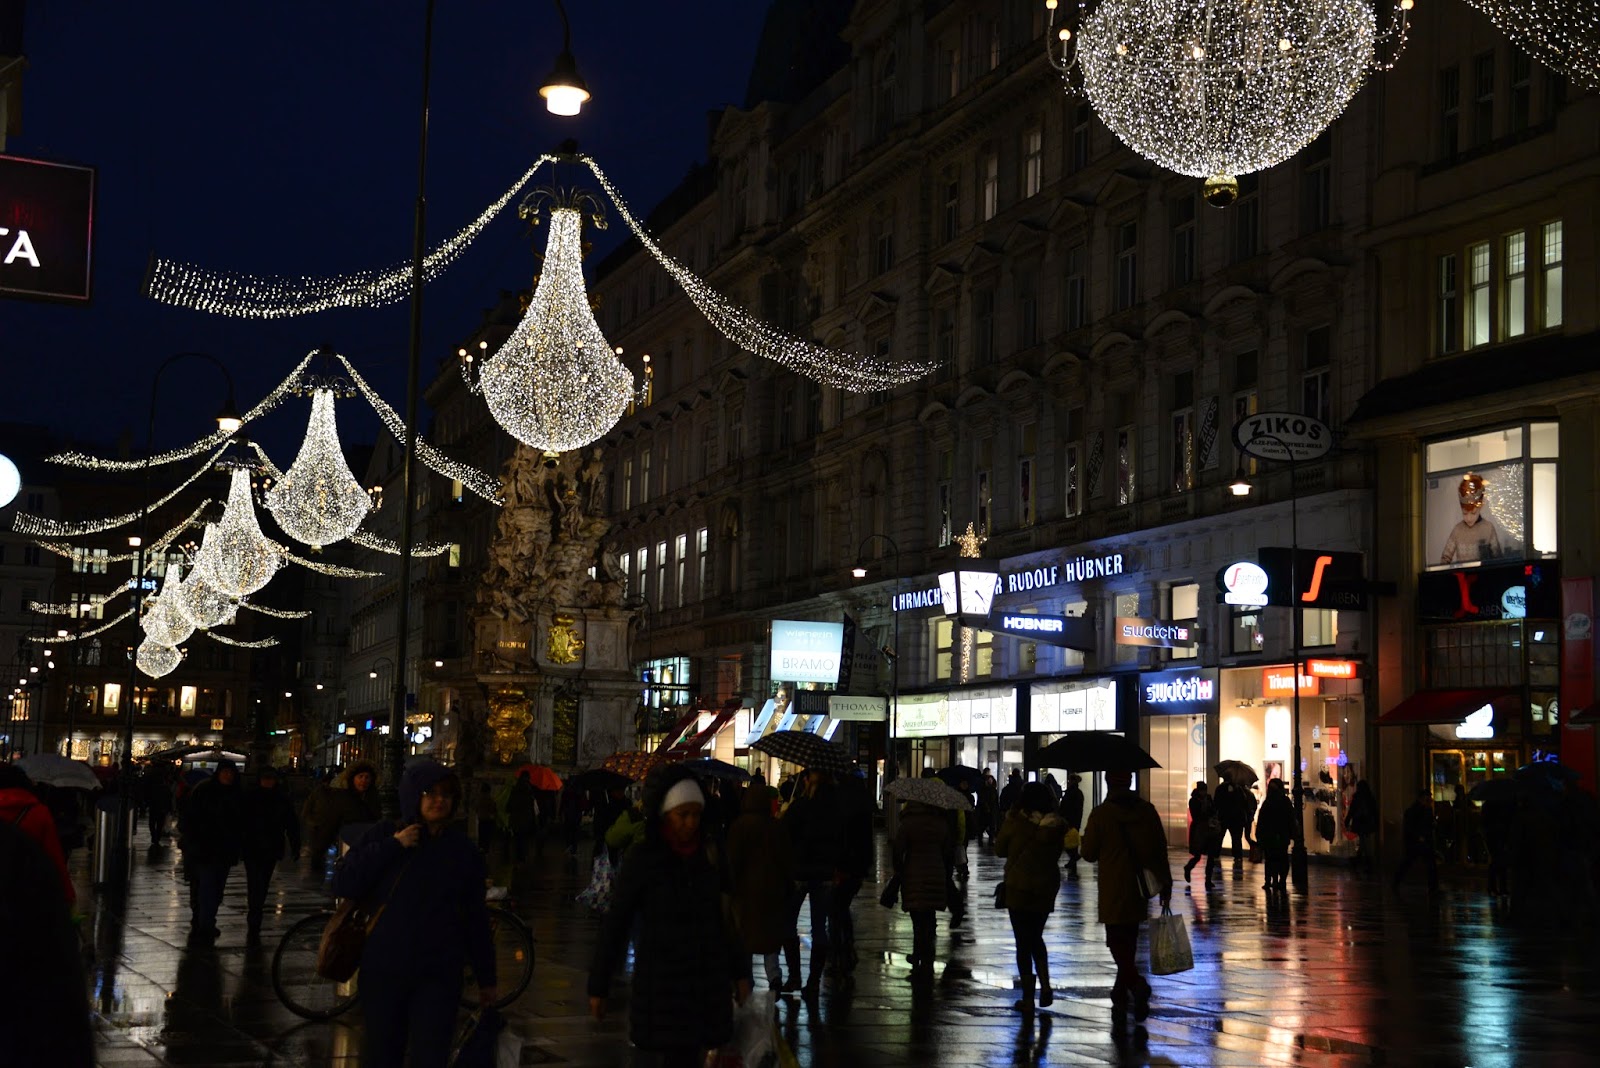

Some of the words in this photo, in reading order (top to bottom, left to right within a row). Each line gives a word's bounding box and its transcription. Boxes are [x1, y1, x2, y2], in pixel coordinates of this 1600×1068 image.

[1249, 418, 1321, 440] ZIKOS
[1009, 565, 1057, 593] RUDOLF
[1065, 553, 1123, 583] HÜBNER
[1123, 624, 1178, 640] swatch
[782, 657, 835, 671] BRAMO
[1312, 662, 1345, 676] Triumph
[1146, 677, 1201, 703] swatch
[1267, 673, 1305, 692] Triumph
[833, 703, 885, 712] THOMAS
